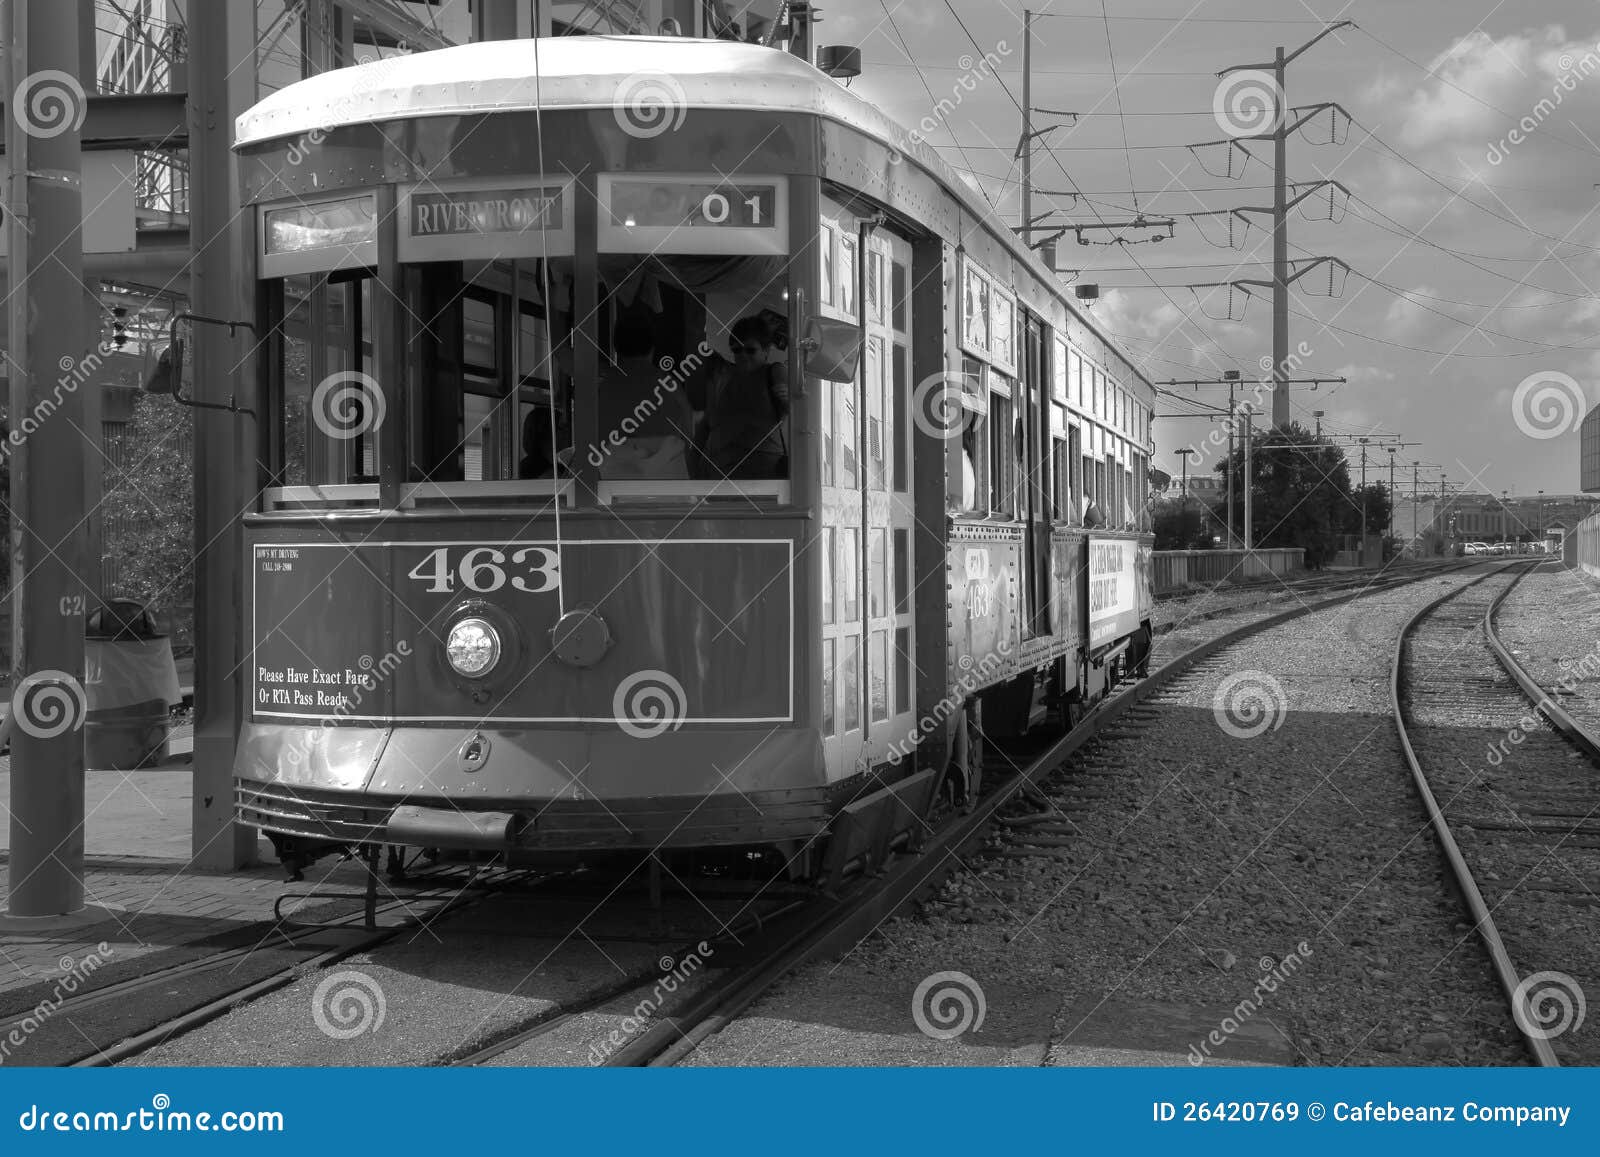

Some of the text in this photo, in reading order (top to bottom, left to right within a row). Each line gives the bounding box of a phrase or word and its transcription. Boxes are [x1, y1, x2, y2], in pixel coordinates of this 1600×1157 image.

[416, 197, 556, 233] RIVERFRONT
[408, 547, 560, 592] 463
[967, 583, 989, 619] 463
[259, 667, 369, 685] Please Have Exact Fare
[259, 688, 348, 710] Or RTA Pass Ready
